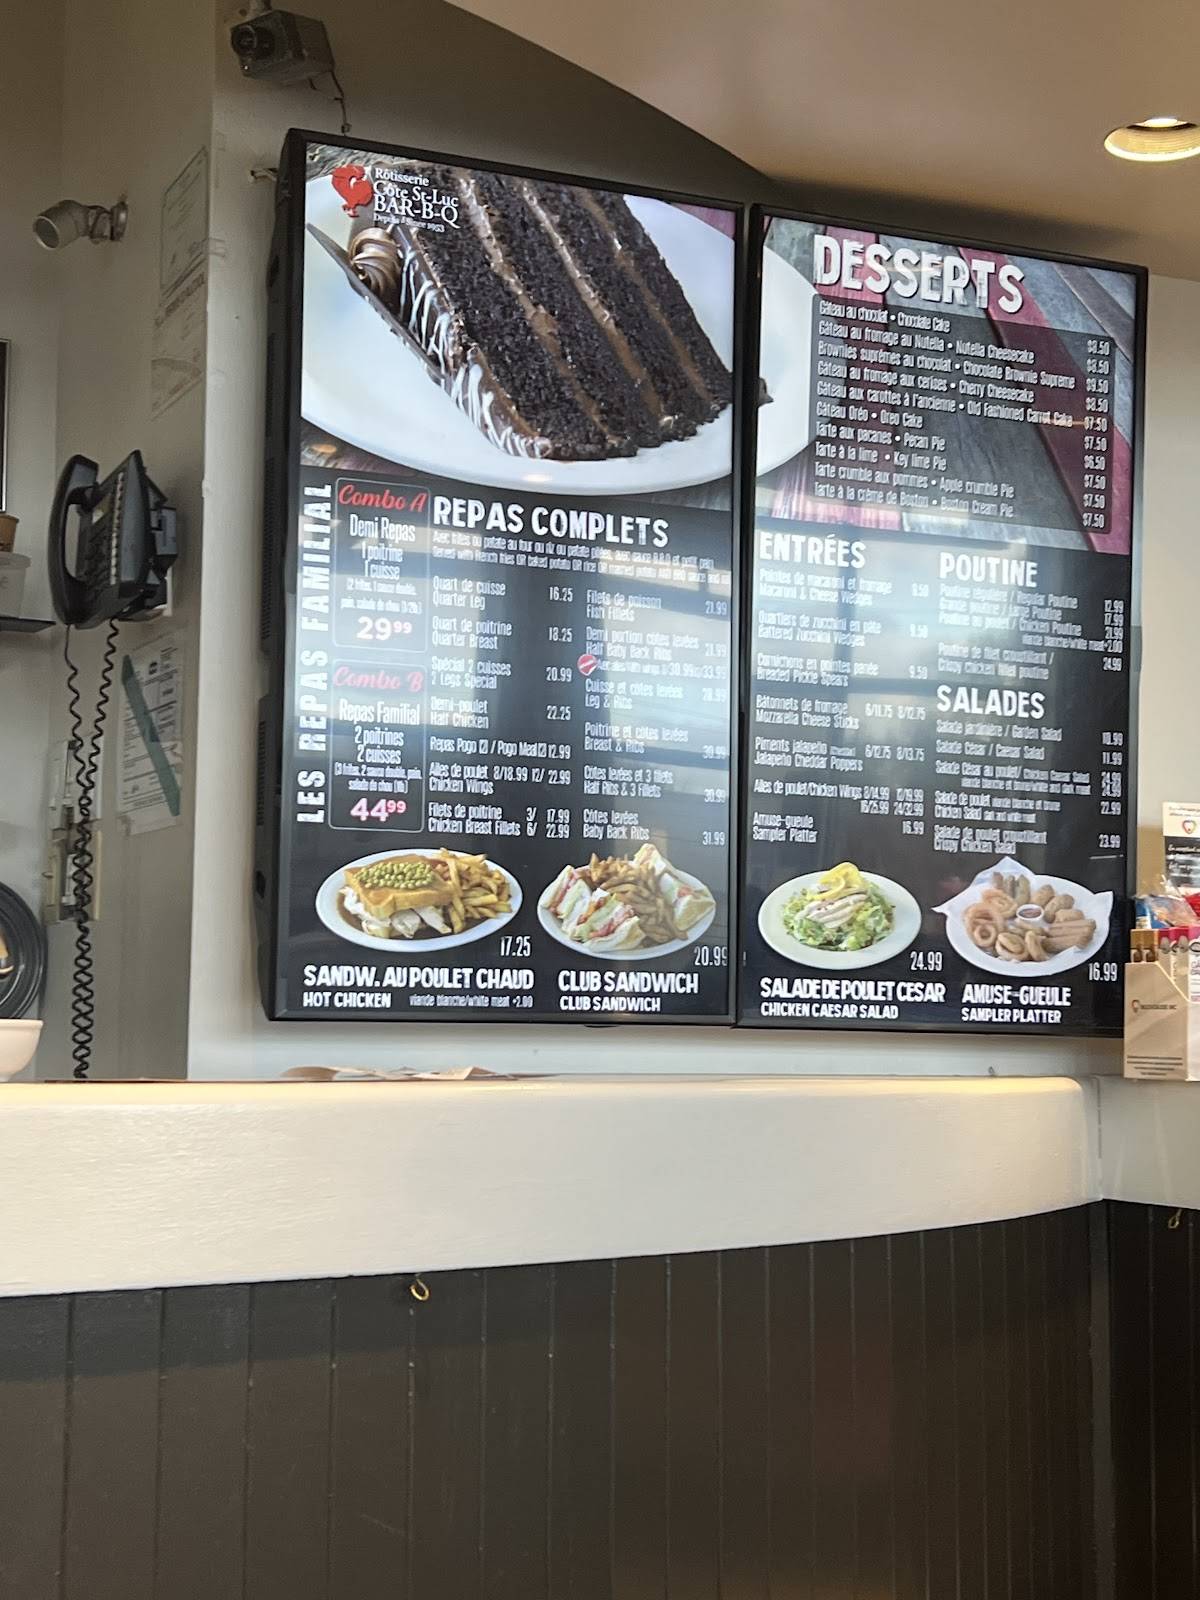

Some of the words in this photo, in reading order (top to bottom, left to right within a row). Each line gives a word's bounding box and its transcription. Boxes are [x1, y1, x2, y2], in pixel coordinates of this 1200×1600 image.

[375, 167, 430, 187] Rôtisserie
[373, 180, 409, 200] Côte
[412, 186, 459, 208] St-Luc
[373, 193, 460, 229] BAR-B-Q
[813, 234, 1025, 314] DESSERTS
[846, 304, 857, 320] au
[898, 311, 932, 330] Chocolate
[932, 317, 951, 333] Cake
[880, 409, 900, 425] Oreo
[902, 412, 923, 428] Cake
[815, 421, 837, 438] Tarte
[839, 425, 855, 440] aux
[857, 427, 892, 445] pacanes
[903, 432, 929, 450] Pecan
[931, 435, 946, 451] Pie
[815, 441, 837, 458] Tarte
[848, 445, 856, 460] la
[858, 447, 878, 463] lime
[894, 451, 909, 468] Key
[932, 455, 947, 471] Pie
[338, 484, 405, 510] Combo
[409, 493, 428, 513] A
[350, 513, 379, 538] Demi
[381, 517, 416, 544] Repas
[433, 495, 525, 534] REPAS
[531, 506, 670, 549] COMPLETS
[301, 484, 332, 632] FAMILIAL
[368, 543, 403, 563] poitrine
[759, 531, 867, 569] ENTRÉES
[370, 562, 400, 580] cuisse
[939, 551, 1038, 588] POUTINE
[433, 576, 457, 591] Quart
[462, 578, 473, 592] de
[477, 580, 506, 596] cuisse
[550, 586, 573, 602] 16.25
[432, 591, 468, 607] Quarter
[470, 595, 486, 611] Leg
[432, 615, 457, 631] Quart
[461, 618, 473, 633] de
[476, 619, 512, 637] poitrine
[548, 627, 573, 643] 18.25
[432, 631, 467, 647] Quarter
[469, 634, 498, 650] Breast
[333, 666, 401, 691] Combo
[408, 671, 424, 692] B
[468, 659, 474, 673] 2
[477, 660, 511, 677] cuisses
[546, 666, 572, 682] 20.99
[431, 671, 437, 686] 2
[440, 673, 461, 688] Legs
[464, 674, 497, 690] Special
[299, 650, 330, 752] REPAS
[339, 698, 374, 725] Repas
[377, 701, 420, 726] Familial
[936, 684, 1046, 720] SALADES
[430, 711, 449, 726] Half
[452, 713, 489, 729] Chicken
[546, 705, 571, 721] 22.25
[354, 725, 362, 744] 2
[363, 727, 404, 747] poitrines
[357, 745, 364, 763] 2
[365, 746, 402, 765] cuisses
[430, 736, 455, 752] Repas
[456, 738, 477, 755] Pogo
[498, 740, 517, 757] Pogo
[548, 744, 571, 760] 12.99
[429, 762, 449, 778] Ailes
[450, 763, 462, 779] de
[463, 764, 489, 780] poulet
[548, 769, 571, 785] 22.99
[296, 770, 326, 823] LES
[429, 776, 464, 793] Chicken
[466, 778, 494, 796] Wings
[428, 802, 453, 818] Filets
[454, 803, 466, 819] de
[468, 805, 502, 821] poitrine
[546, 809, 570, 825] 17.99
[753, 811, 814, 829] Amuse-gueule
[428, 817, 463, 833] Chicken
[465, 819, 492, 835] Breast
[546, 823, 570, 839] 22.99
[583, 823, 604, 840] Baby
[607, 825, 628, 840] Back
[631, 826, 650, 841] Ribs
[702, 831, 726, 847] 31.99
[752, 825, 787, 842] Sampler
[789, 827, 818, 843] Platter
[500, 936, 532, 959] 17.25
[910, 950, 943, 971] 24.99
[303, 964, 380, 988] SANDW.
[382, 966, 407, 988] AU
[409, 966, 473, 989] POULET
[476, 968, 535, 990] CHAUD
[558, 970, 601, 992] CLUB
[603, 972, 699, 994] SANDWICH
[1088, 962, 1118, 982] 16.99
[302, 991, 331, 1008] HOT
[333, 992, 392, 1009] CHICKEN
[760, 976, 821, 998] SALADE
[822, 979, 840, 999] DE
[841, 979, 895, 1001] POULET
[896, 983, 946, 1003] CESAR
[961, 983, 1072, 1006] AMUSE-GUEULE
[559, 995, 591, 1011] CLUB
[592, 997, 661, 1012] SANDWICH
[760, 1001, 810, 1017] CHICKEN
[811, 1003, 858, 1019] CAESAR
[859, 1005, 899, 1019] SALAD
[961, 1007, 1012, 1022] SAMPLER
[1012, 1009, 1062, 1024] PLATTER
